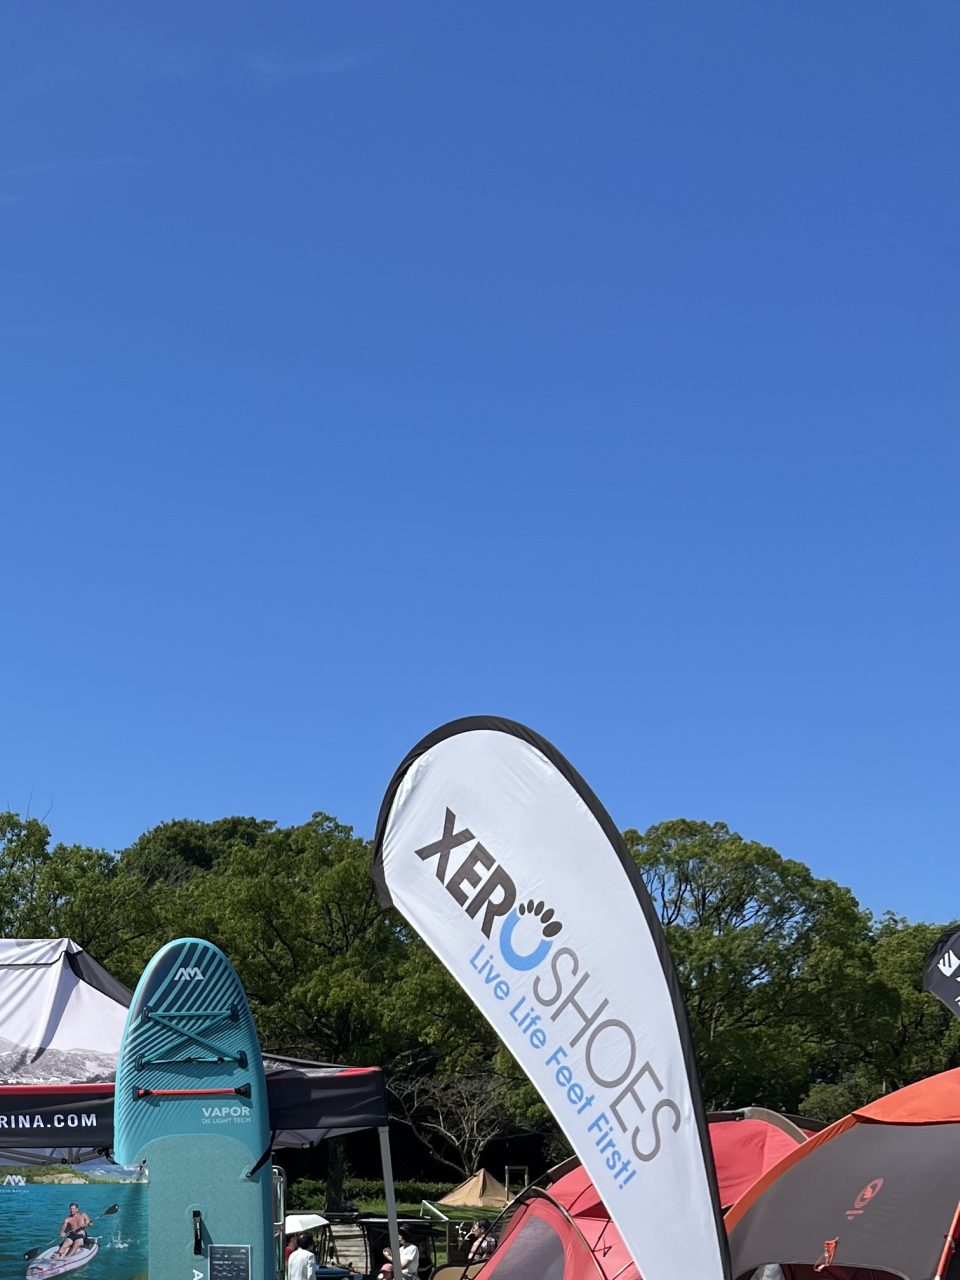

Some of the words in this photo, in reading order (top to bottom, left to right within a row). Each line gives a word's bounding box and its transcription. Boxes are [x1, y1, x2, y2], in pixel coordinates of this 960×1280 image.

[202, 1106, 251, 1117] VAPOR
[470, 943, 510, 1001] Live
[509, 996, 547, 1050] Life
[545, 1046, 596, 1115] Feet
[587, 1111, 638, 1190] First!
